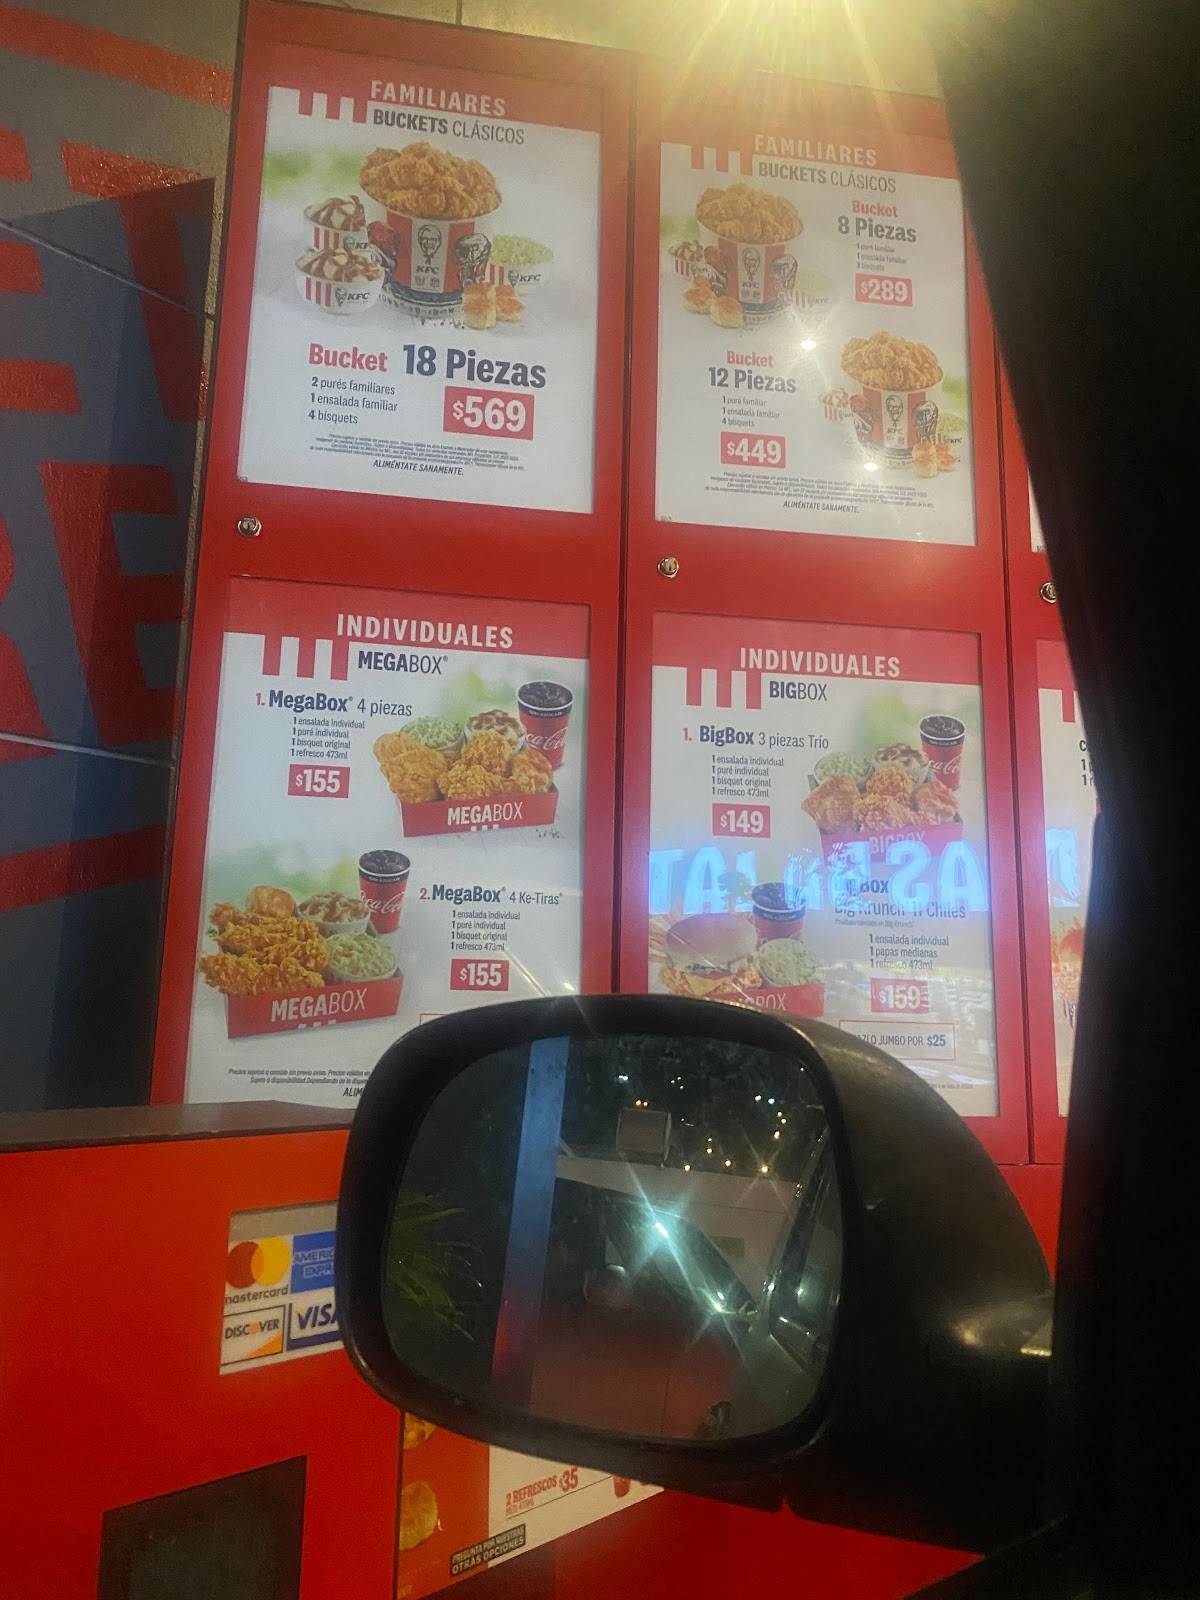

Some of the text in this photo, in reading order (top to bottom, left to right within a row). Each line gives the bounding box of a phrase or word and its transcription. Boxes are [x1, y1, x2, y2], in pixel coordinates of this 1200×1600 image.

[370, 79, 506, 117] FAMILIARES
[373, 108, 525, 145] BUCKETS CLÁSICOS
[754, 134, 878, 167] FAMILIARES
[758, 162, 897, 193] BUCKETS CLÁSICOS
[852, 200, 898, 218] Bucket
[837, 215, 917, 243] 8 Piezas
[416, 265, 440, 275] KFC
[518, 273, 541, 282] KFC
[347, 291, 370, 301] KFC
[860, 279, 908, 300] $289
[308, 343, 547, 389] Bucket 18 Piezas
[727, 351, 774, 368] Bucket
[320, 377, 347, 391] purés
[349, 380, 396, 395] familiares
[709, 367, 797, 393] 12 Piezas
[317, 393, 360, 408] ensalada
[361, 397, 398, 412] familiar
[452, 395, 526, 432] $569
[727, 438, 782, 464] $449
[373, 458, 465, 476] ALIMÉNTATE SANAMENTE.
[337, 613, 513, 649] INDIVIDUALES
[740, 648, 901, 678] INDIVIDUALES
[769, 680, 828, 701] BIGBOX
[255, 692, 265, 706] 1.
[357, 700, 366, 714] 4
[370, 700, 412, 717] piezas
[298, 717, 330, 727] ensalada
[331, 718, 365, 729] individual
[297, 727, 314, 738] puré
[315, 728, 349, 739] individual
[683, 725, 829, 750] 1. BigBox 3 piezas Trío
[296, 737, 323, 749] bisquet
[324, 739, 351, 750] original
[296, 748, 324, 758] refresco
[325, 750, 347, 759] 473ml
[717, 756, 749, 765] ensalada
[749, 757, 784, 767] individual
[295, 768, 341, 793] $155
[717, 766, 733, 776] puré
[734, 767, 769, 777] individual
[717, 777, 743, 787] bisquet
[744, 777, 771, 788] original
[717, 787, 746, 797] refresco
[746, 788, 769, 798] 473ml
[447, 801, 523, 826] MEGABOX
[720, 809, 764, 833] $149
[420, 888, 430, 900] 2.
[457, 911, 487, 919] ensalada
[488, 911, 520, 920] individual
[927, 901, 966, 918] Chiles
[457, 920, 472, 930] puré
[473, 921, 506, 930] individual
[456, 931, 481, 941] bisquet
[482, 932, 507, 942] original
[875, 934, 909, 945] ensalada
[911, 935, 949, 946] individual
[456, 942, 482, 951] refresco
[484, 942, 505, 951] 473ml
[876, 948, 898, 958] papas
[900, 948, 938, 957] medianas
[459, 962, 502, 986] $155
[271, 988, 368, 1023] MEGABOX
[879, 984, 921, 1009] $159
[878, 1035, 906, 1046] JUMBO
[907, 1035, 924, 1046] POR
[927, 1034, 946, 1047] $25
[225, 1318, 280, 1340] DISCOVER
[513, 1475, 558, 1503] REFRESCOS
[452, 1536, 524, 1575] OTRAS OPCIONES
